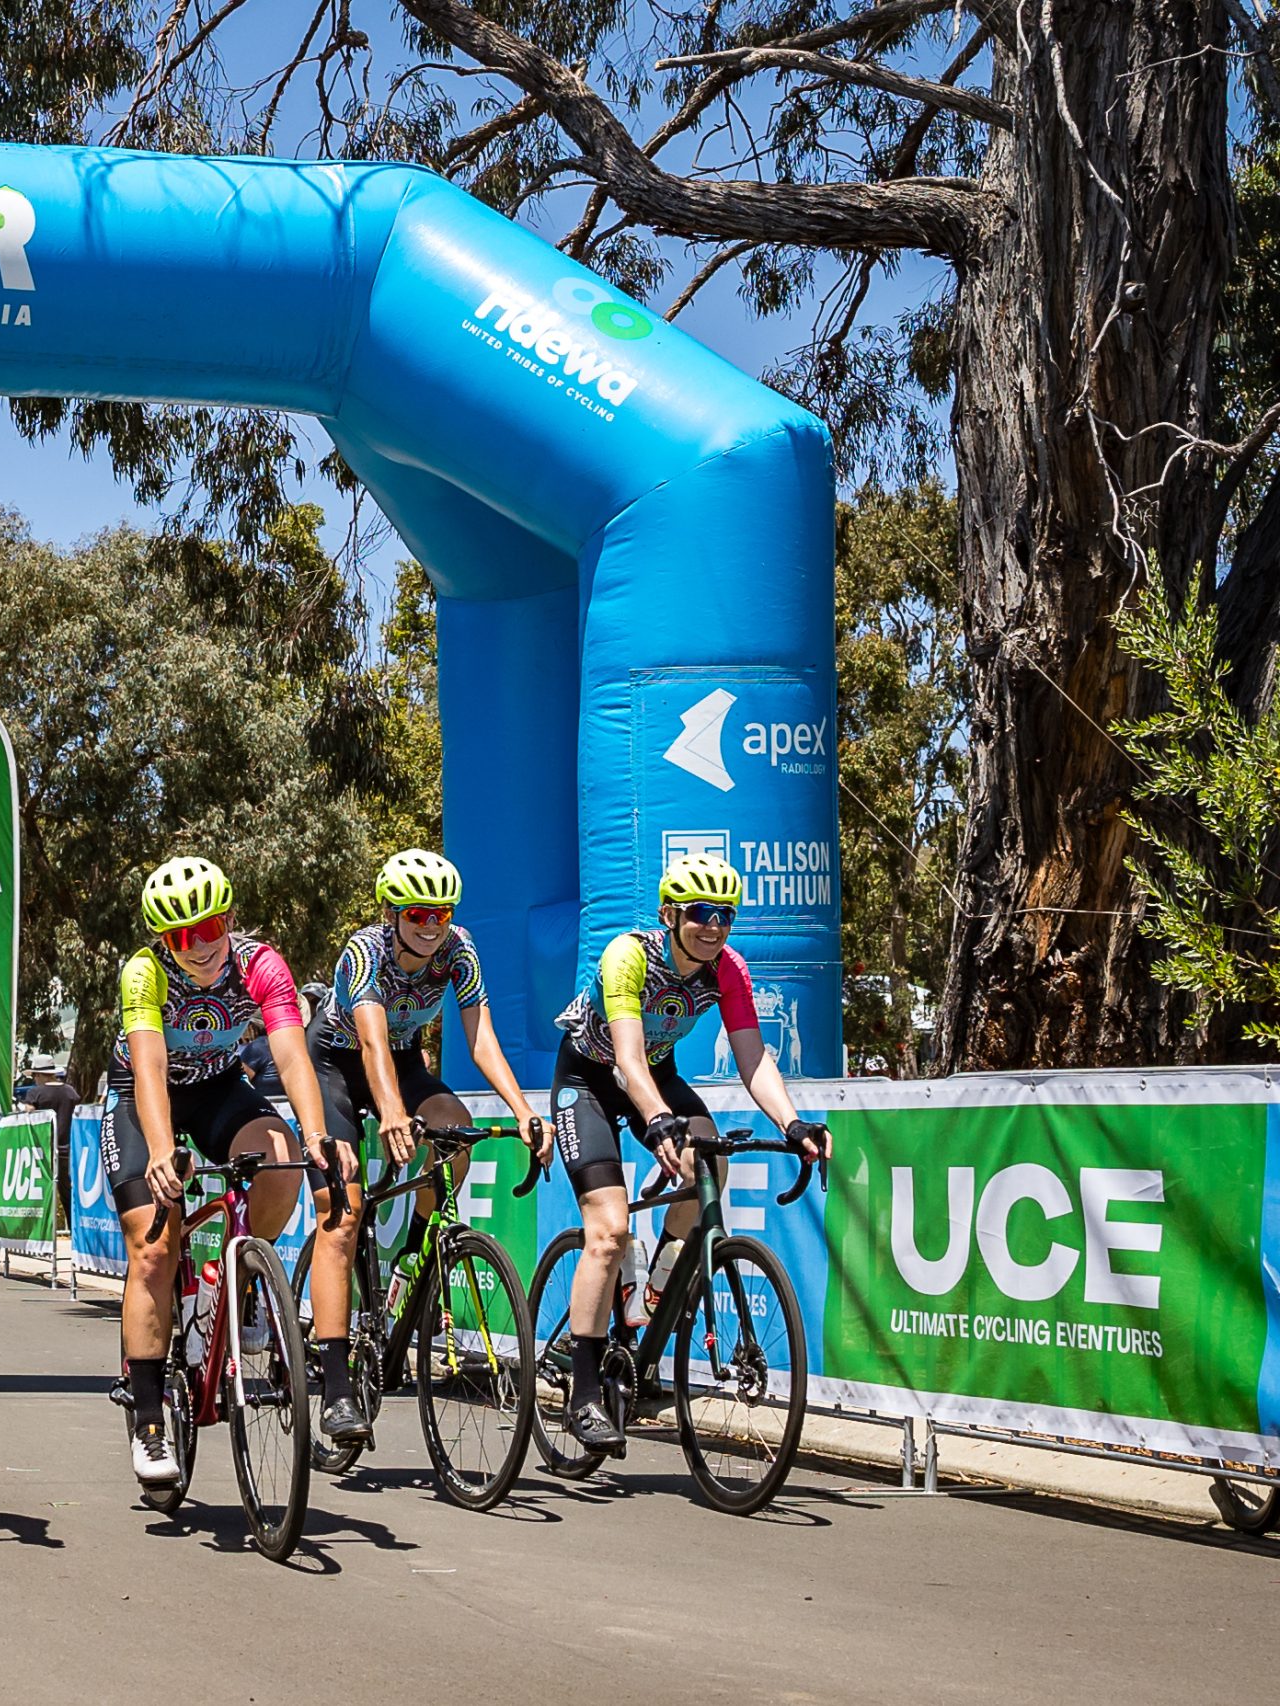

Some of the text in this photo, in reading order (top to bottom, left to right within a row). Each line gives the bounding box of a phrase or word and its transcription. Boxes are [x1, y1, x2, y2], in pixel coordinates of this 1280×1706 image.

[461, 319, 615, 423] UNITED TRIBES OF CYCLING
[474, 289, 638, 407] ridewa
[742, 715, 827, 767] apex
[781, 763, 826, 775] RADIOLOGY
[740, 841, 830, 872] TALISON
[741, 875, 831, 906] LITHIUM
[565, 1108, 580, 1160] exercise
[2, 1146, 44, 1201] UCE
[890, 1162, 1165, 1309] UCE
[890, 1309, 1163, 1358] ULTIMATE CYCLING EVENTURES
